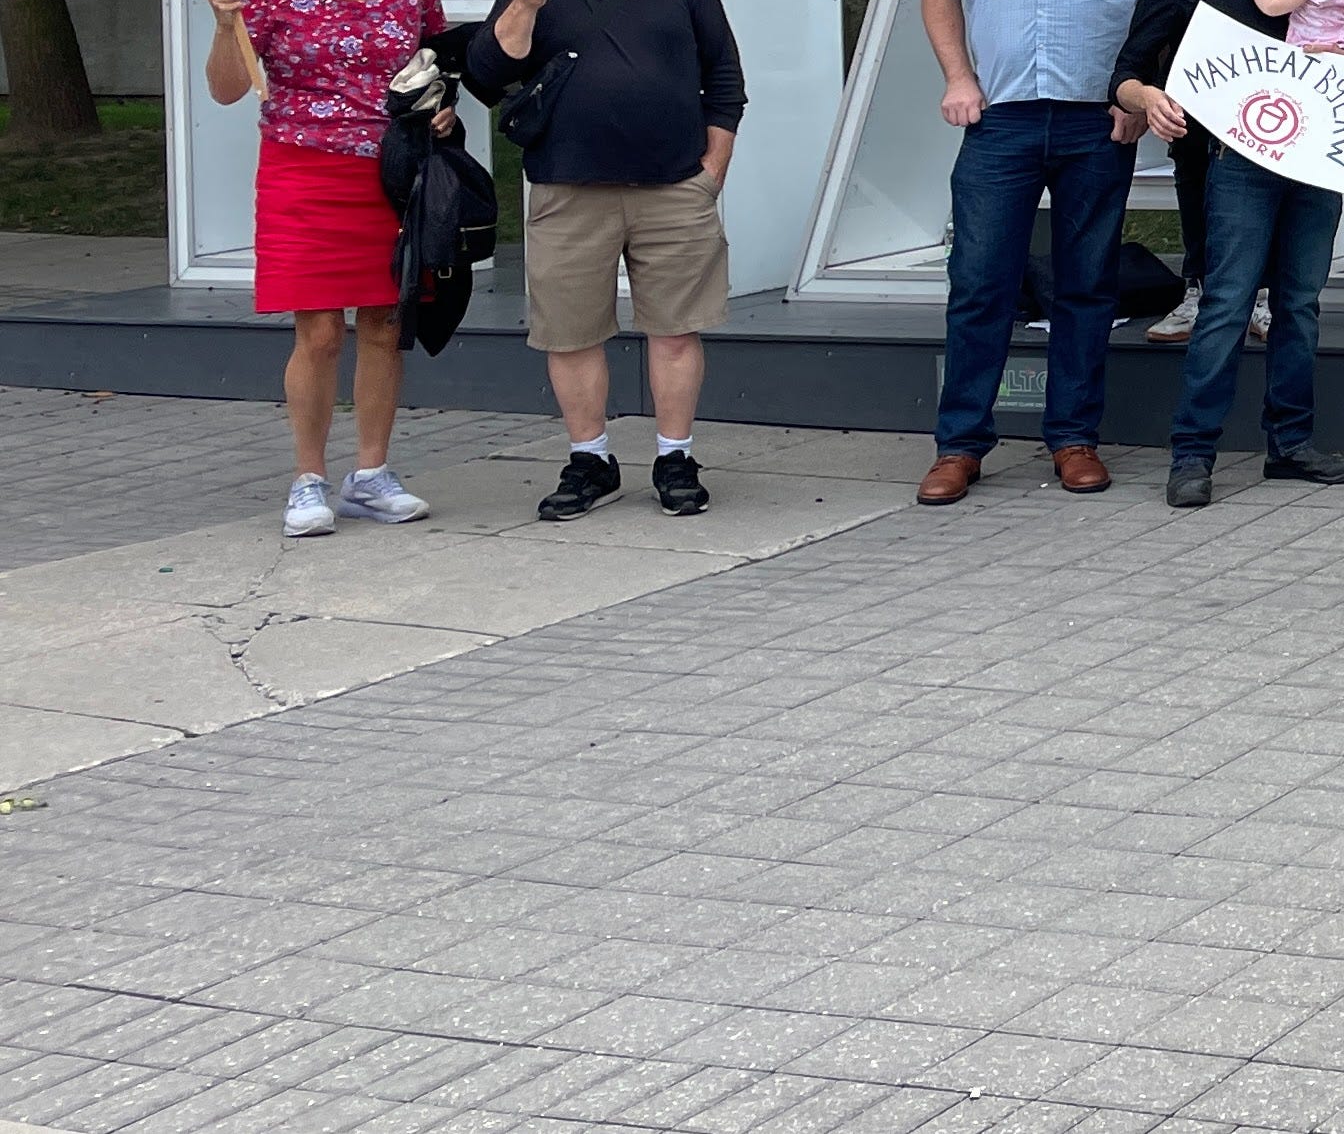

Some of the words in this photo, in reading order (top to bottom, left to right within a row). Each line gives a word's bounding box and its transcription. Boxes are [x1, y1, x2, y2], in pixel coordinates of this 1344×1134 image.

[1183, 53, 1240, 94] MAX
[1240, 45, 1321, 80] HEAT
[1226, 126, 1285, 162] ACORN
